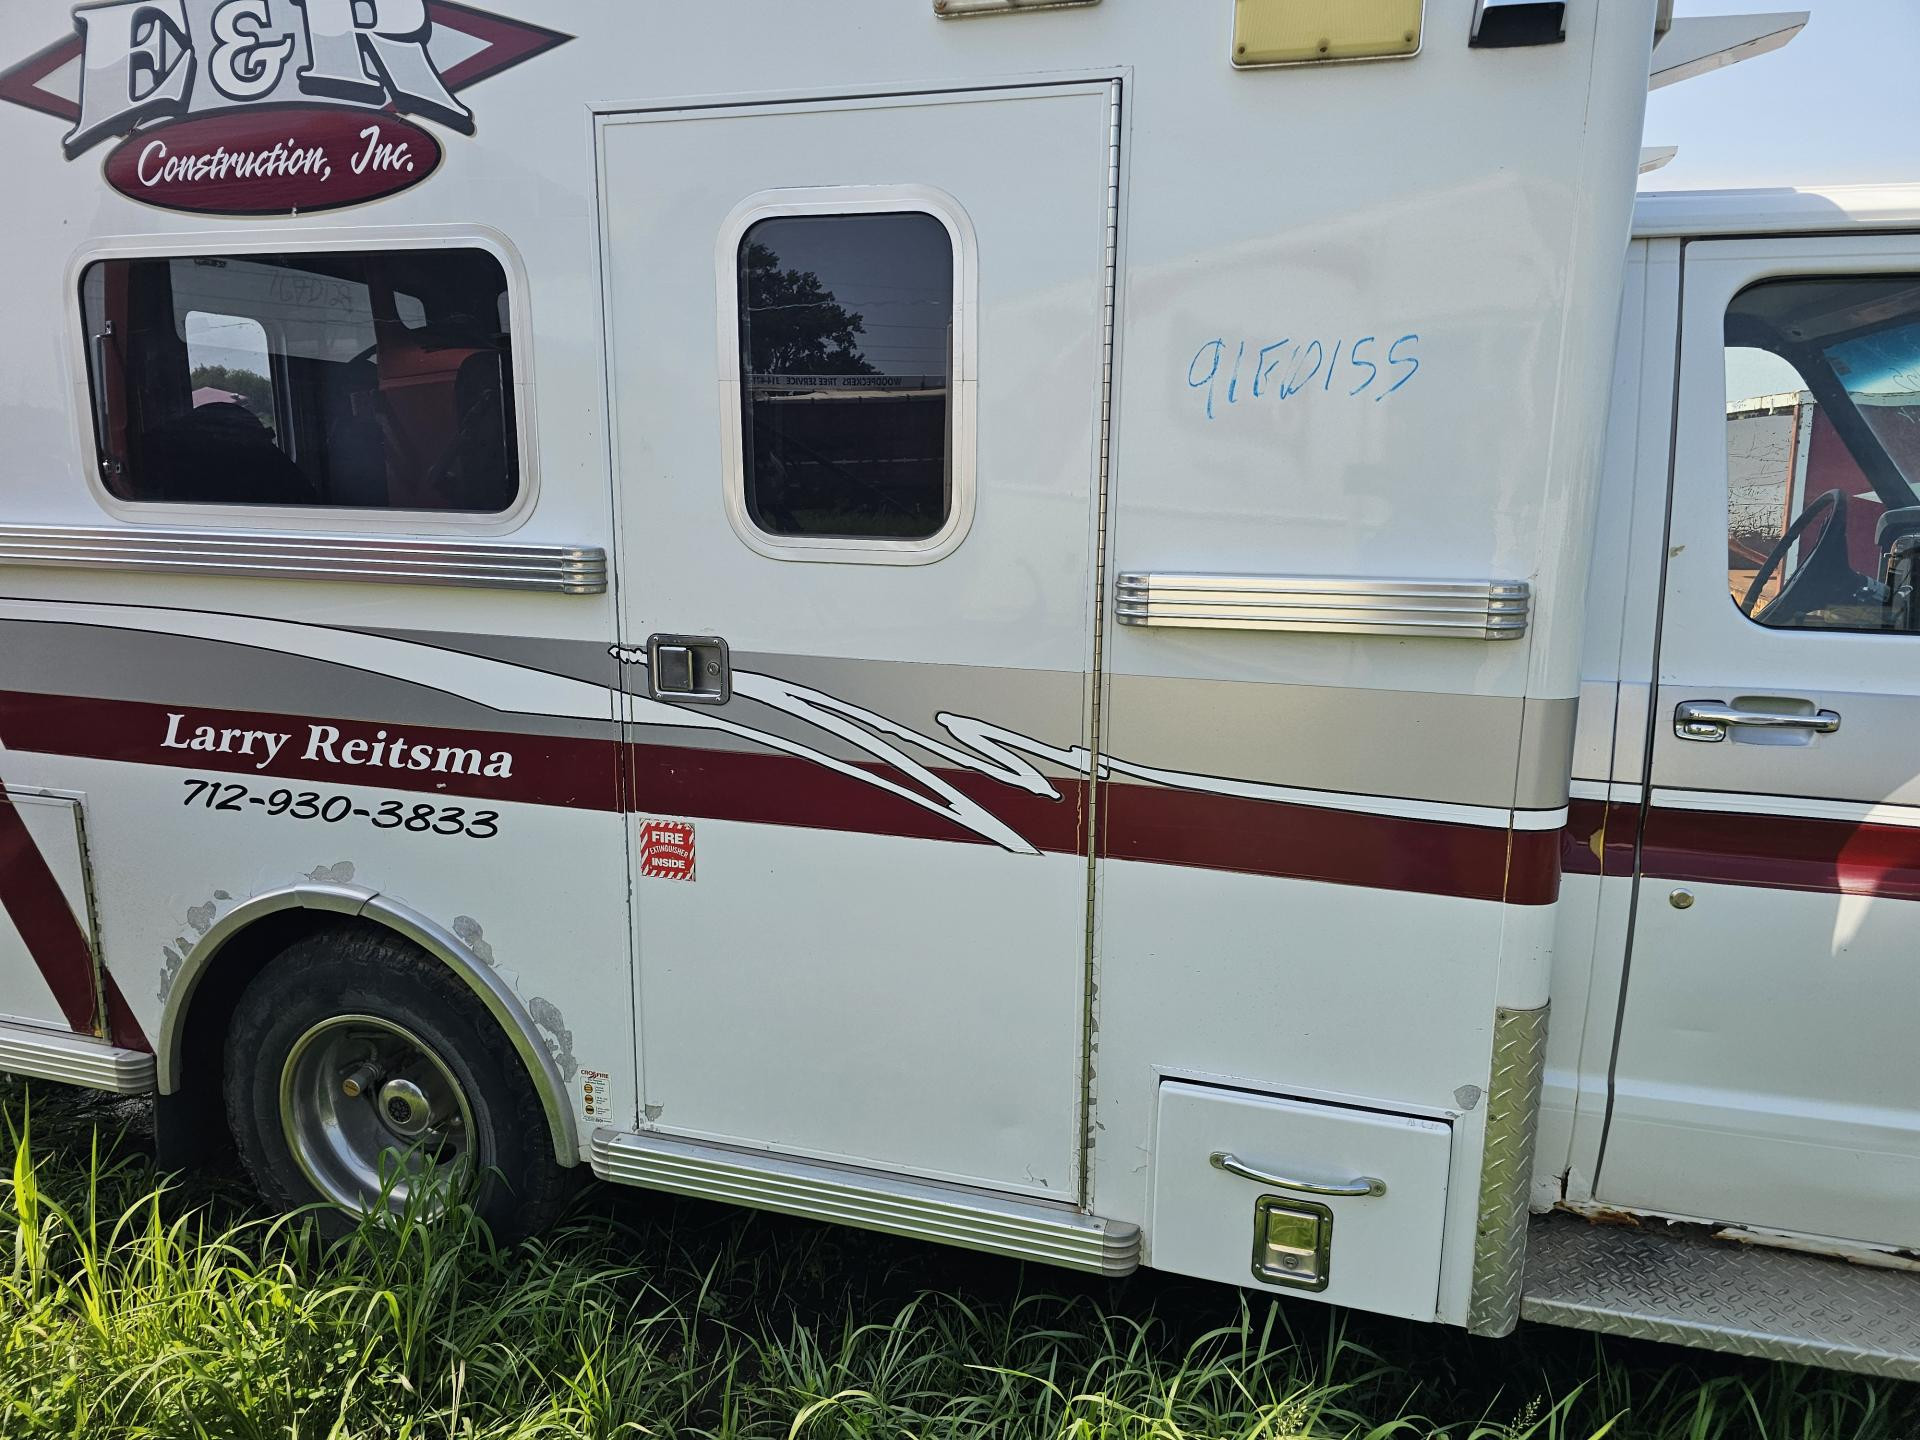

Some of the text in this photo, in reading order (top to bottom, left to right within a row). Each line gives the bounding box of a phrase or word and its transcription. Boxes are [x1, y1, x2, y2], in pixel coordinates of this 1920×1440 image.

[137, 125, 414, 188] Construction, Inc.
[160, 712, 513, 778] Larry Reitsma
[184, 779, 499, 838] 712-930-3833
[649, 844, 689, 859] EXTINGUISHER
[651, 830, 684, 845] FIRE
[651, 857, 686, 869] INSIDE
